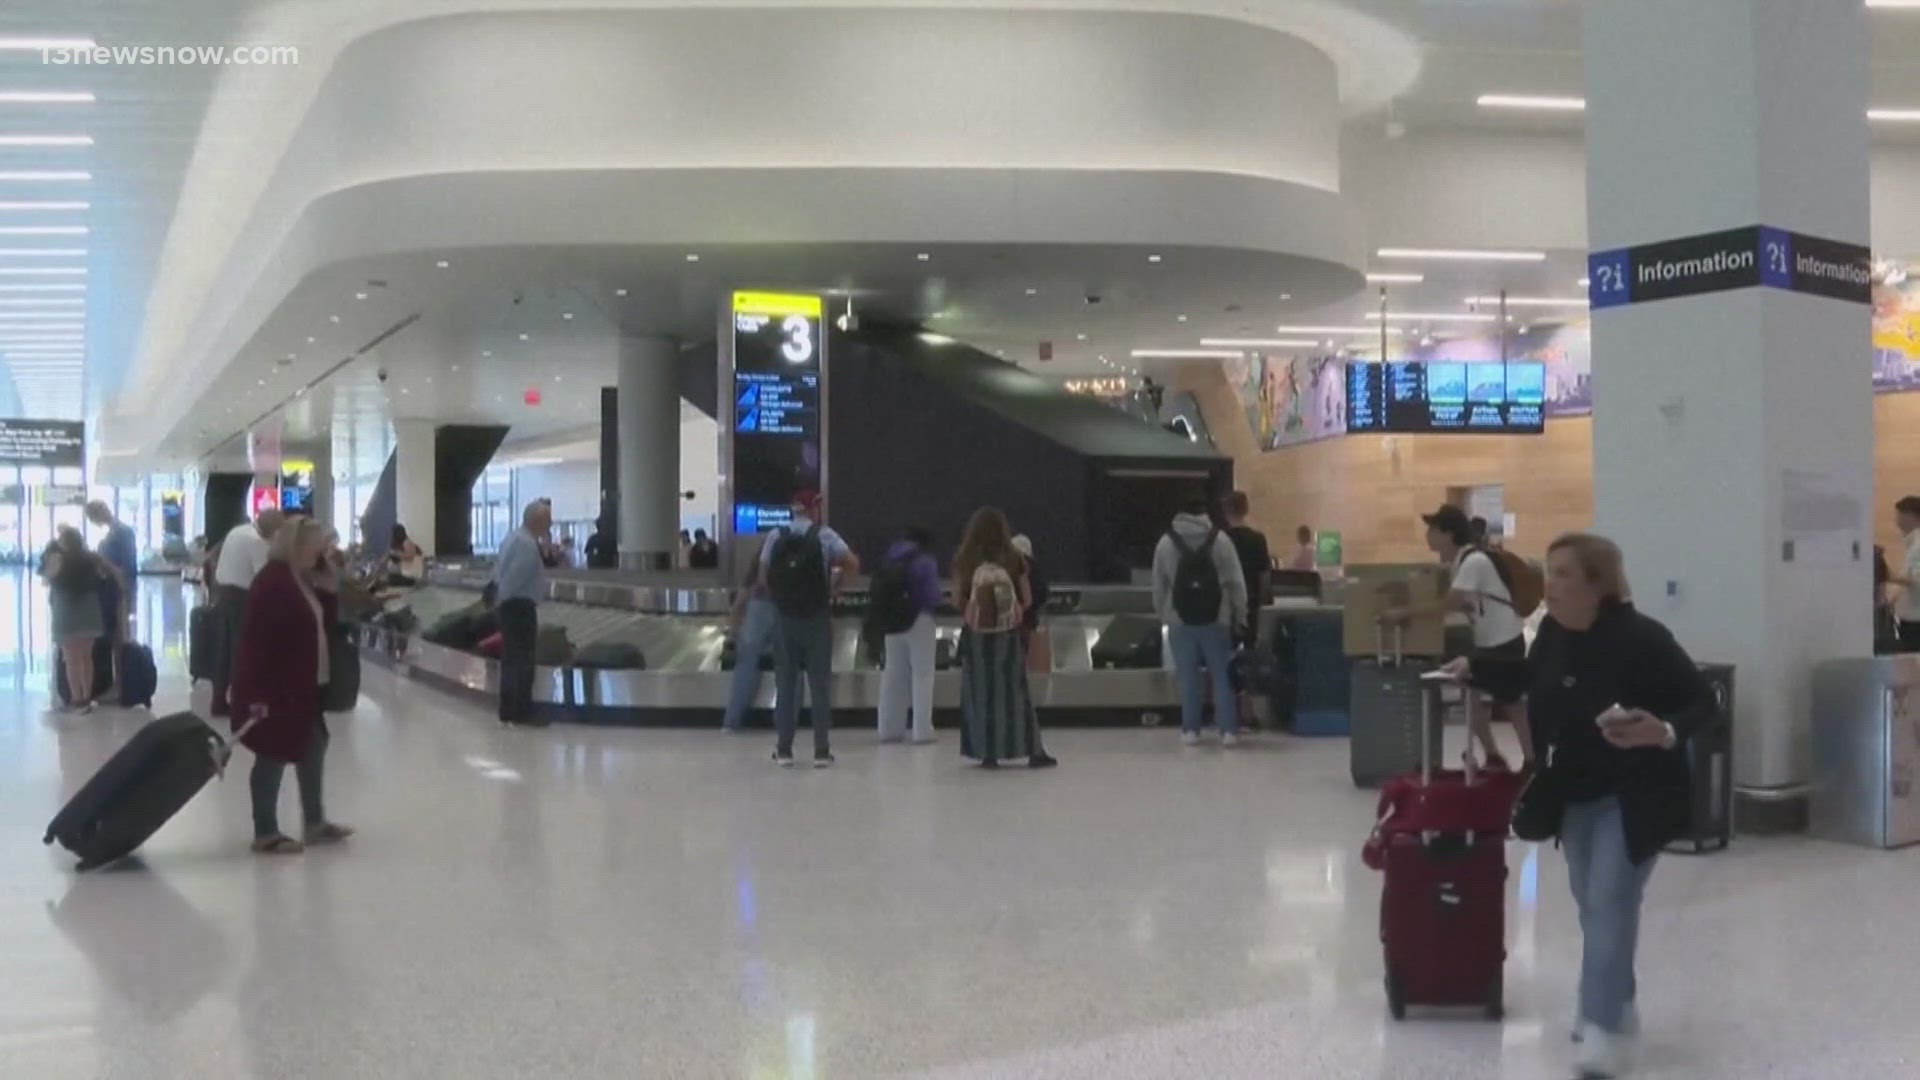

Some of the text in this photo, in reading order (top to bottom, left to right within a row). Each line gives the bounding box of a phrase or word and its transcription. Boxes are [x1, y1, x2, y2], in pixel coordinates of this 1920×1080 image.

[1638, 249, 1754, 284] Information
[1796, 252, 1870, 286] Information
[782, 314, 812, 363] 3
